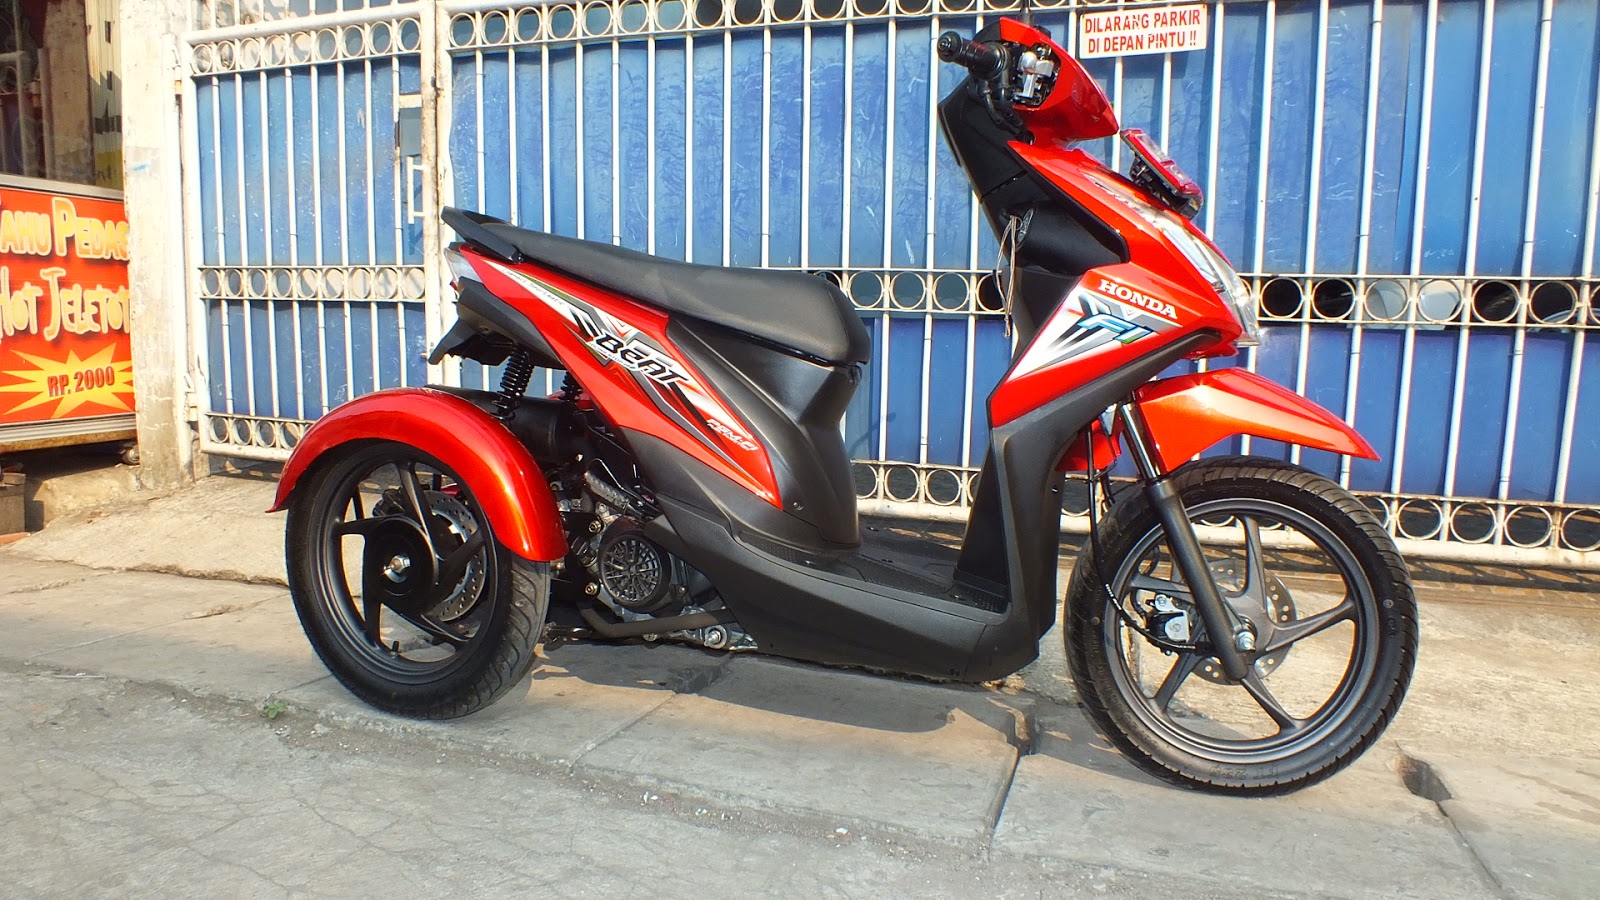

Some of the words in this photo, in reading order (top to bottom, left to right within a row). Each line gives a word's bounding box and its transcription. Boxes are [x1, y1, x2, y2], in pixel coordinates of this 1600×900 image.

[1085, 13, 1149, 34] DILARANG
[1154, 9, 1200, 28] PARKIR
[1088, 38, 1100, 53] DI
[1103, 34, 1144, 52] DEPAN
[1148, 31, 1185, 49] PINTU
[0, 197, 51, 256] AHU
[1098, 279, 1178, 320] HONDA
[73, 366, 115, 393] 2000
